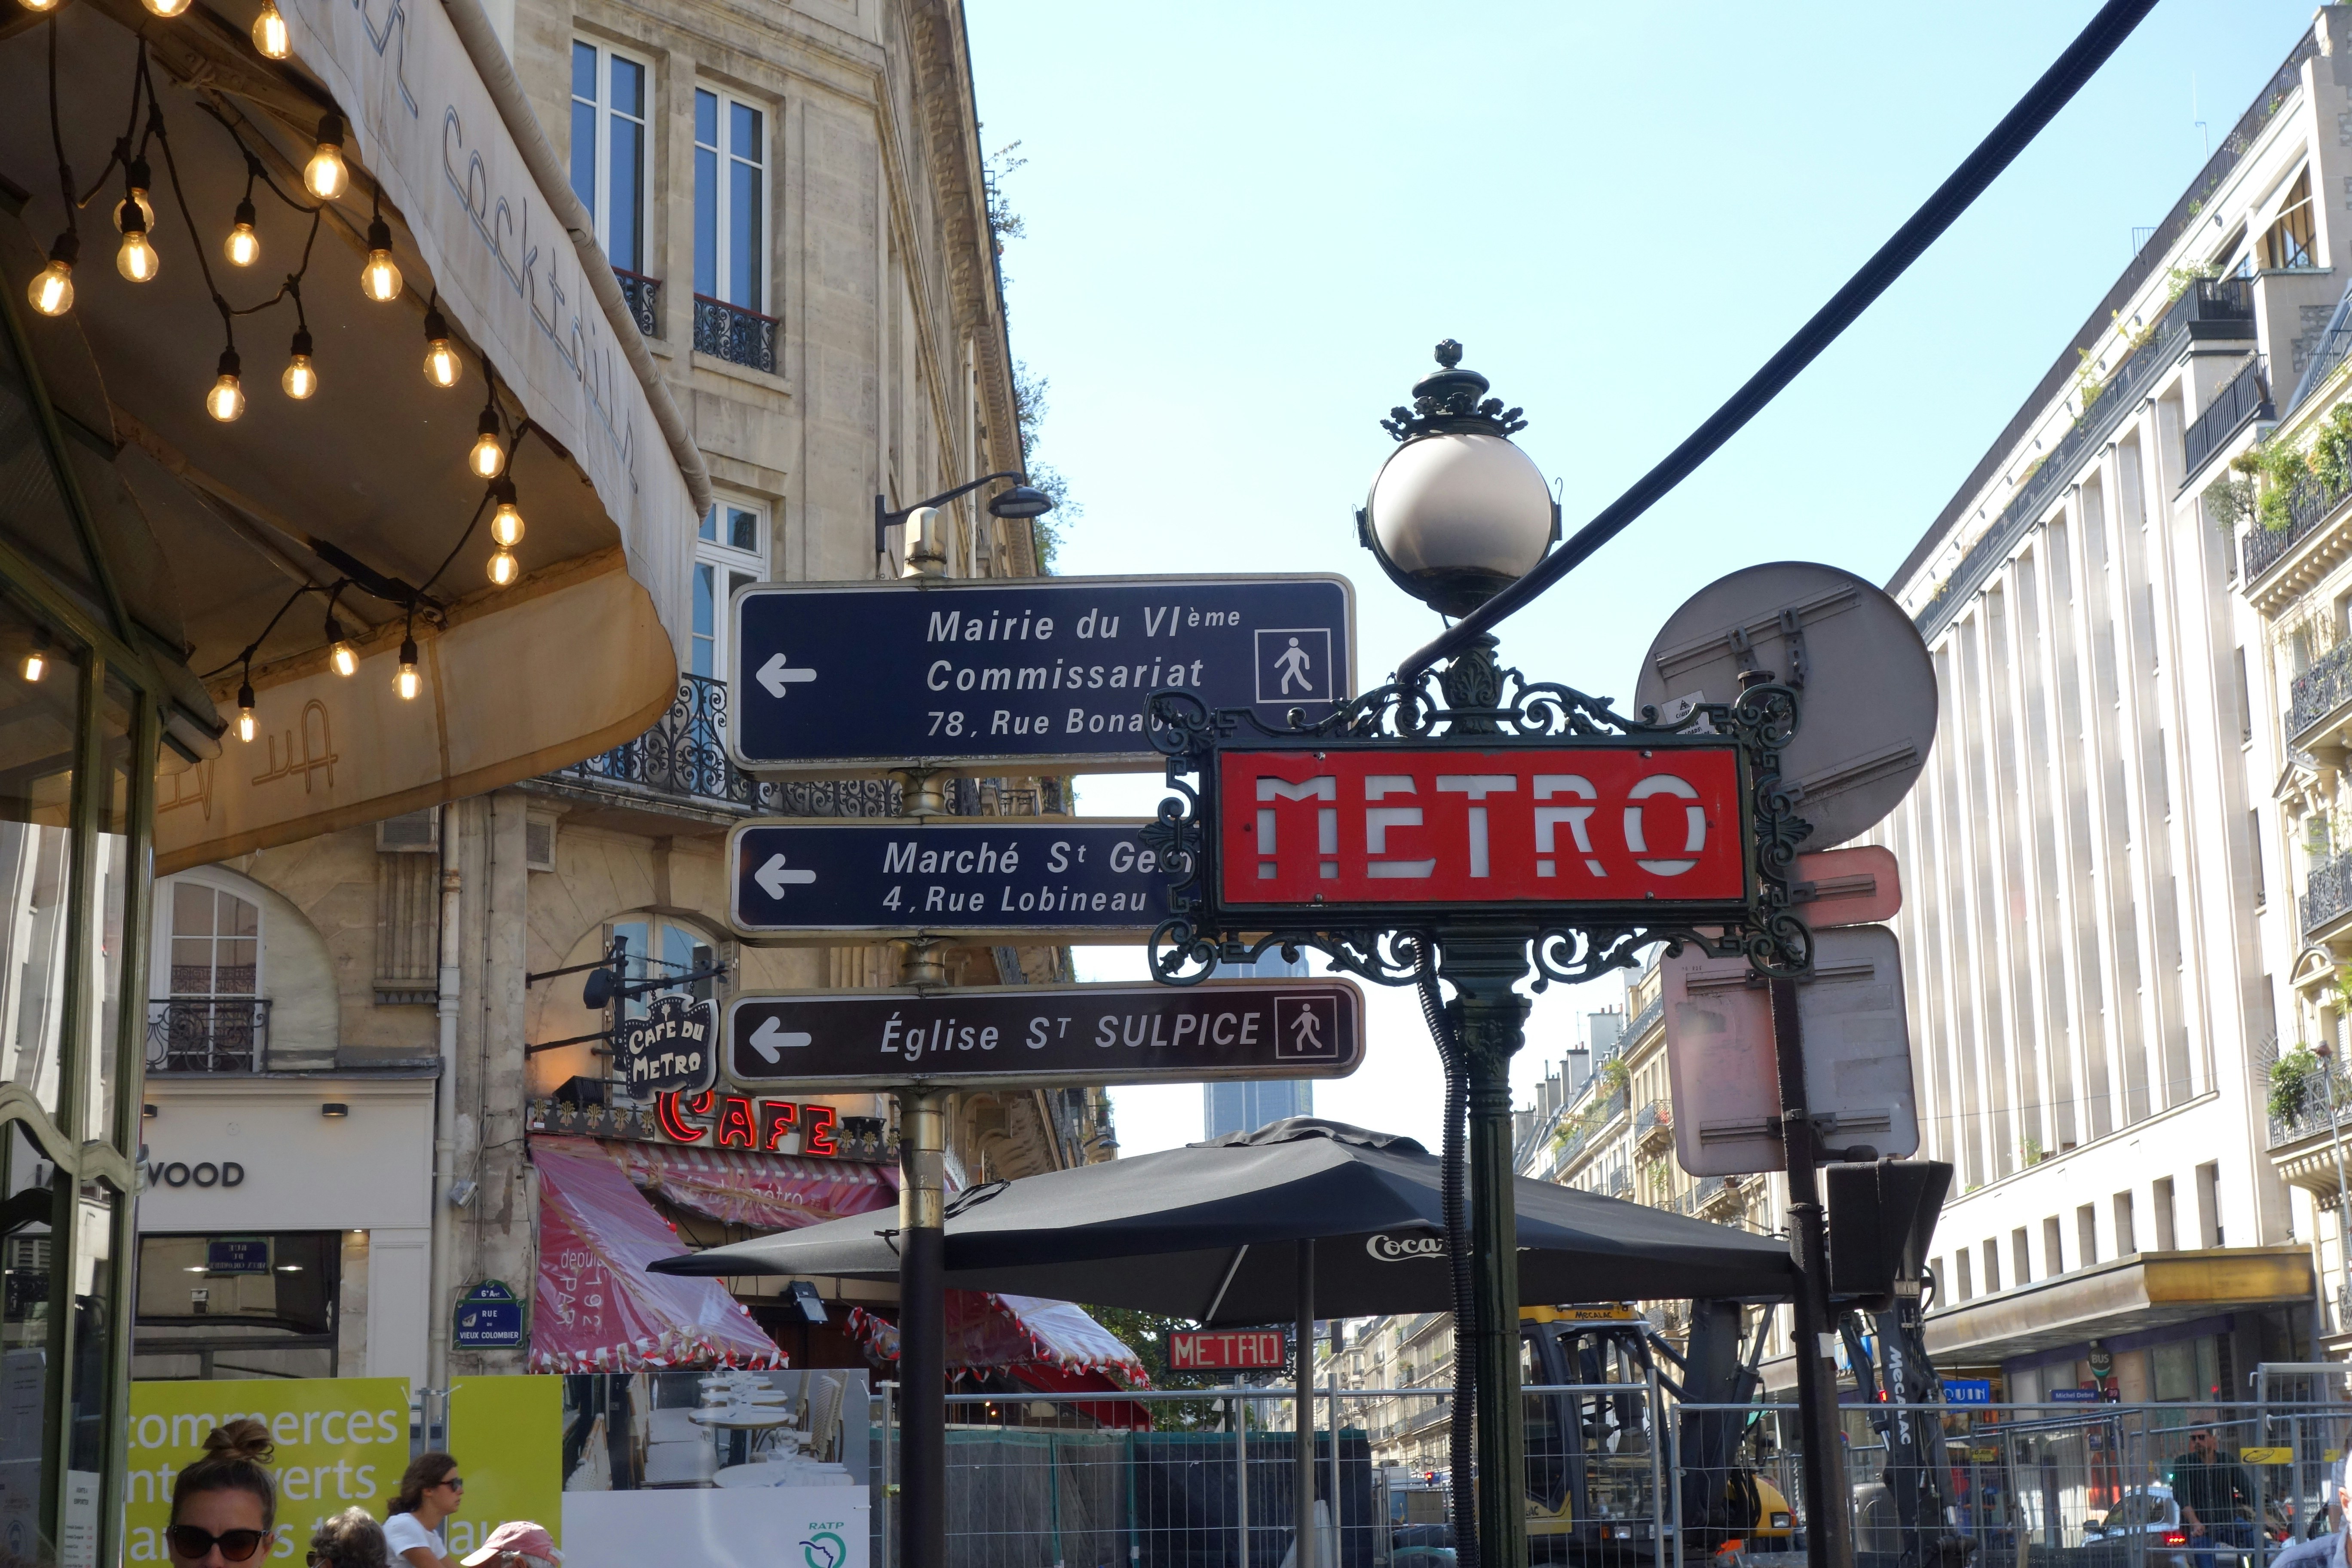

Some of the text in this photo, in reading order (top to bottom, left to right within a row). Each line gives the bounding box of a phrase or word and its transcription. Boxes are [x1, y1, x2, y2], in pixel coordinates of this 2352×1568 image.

[927, 606, 1240, 642] Mairie du VIème
[927, 657, 1204, 691] Commissariat
[990, 710, 1050, 735] Rue
[1256, 774, 1707, 879] METRO
[882, 842, 1019, 874] Marché
[1047, 842, 1086, 873] St
[925, 886, 985, 912] Rue
[1001, 886, 1147, 912] Lobineau
[629, 1020, 704, 1054] CAFE DU
[880, 1012, 1261, 1062] Église ST SULPICE
[633, 1052, 701, 1082] METRO
[655, 1090, 837, 1156] CAFE
[2091, 1354, 2109, 1364] BUS
[808, 1522, 844, 1530] RATP
